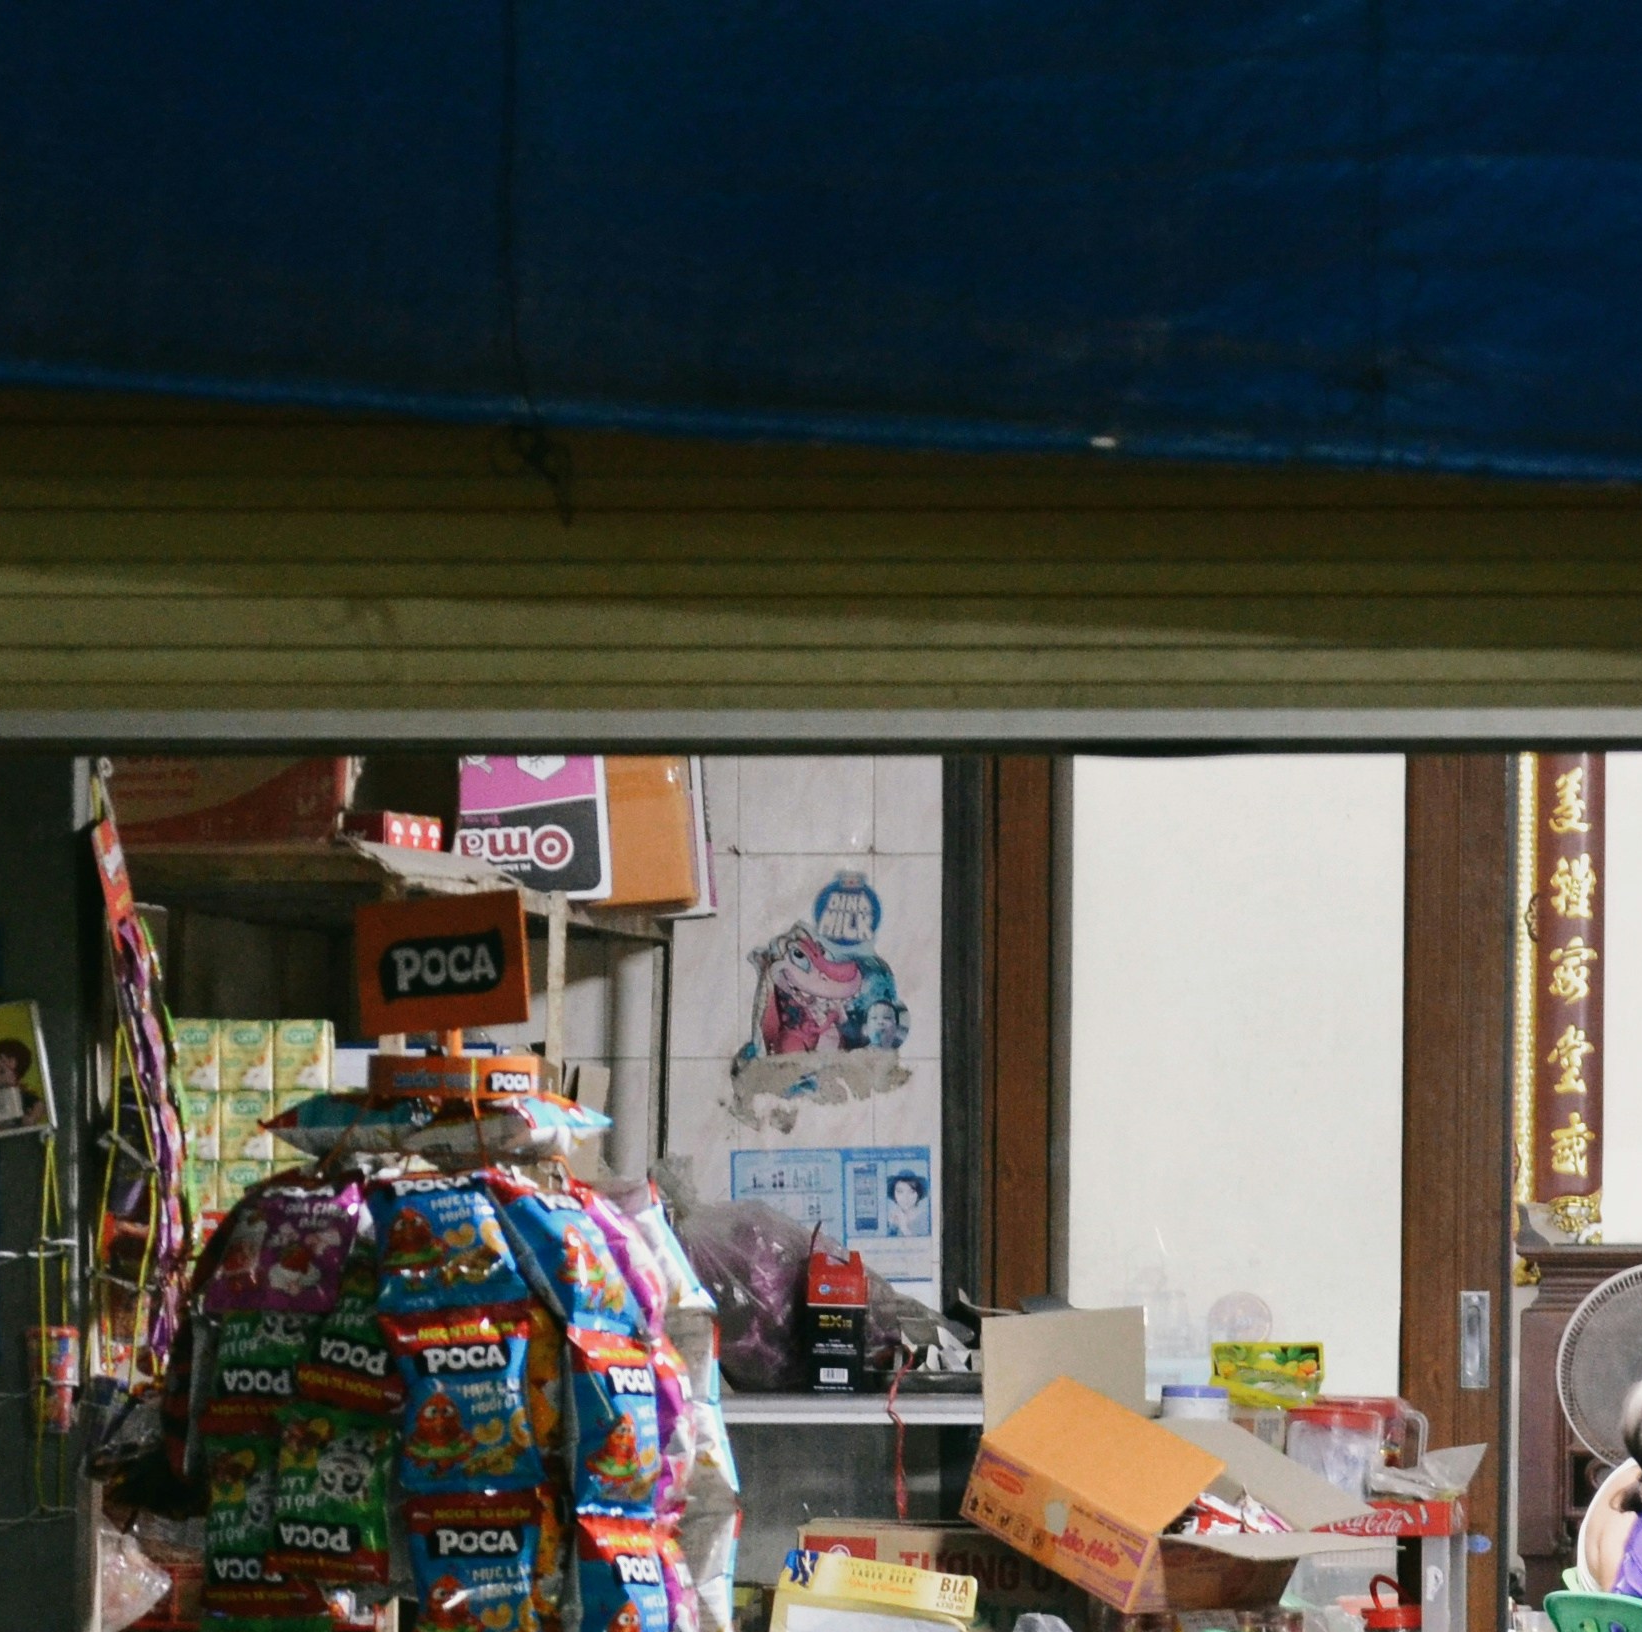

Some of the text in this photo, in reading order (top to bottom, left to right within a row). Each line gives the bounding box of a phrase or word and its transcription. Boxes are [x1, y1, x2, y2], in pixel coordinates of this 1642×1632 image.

[391, 943, 497, 992] POCA
[490, 1071, 530, 1092] POCA
[319, 1336, 389, 1376] POCA
[423, 1344, 506, 1374] POCA
[223, 1369, 292, 1396] POCA
[609, 1366, 655, 1394] POCA
[279, 1522, 351, 1553] POCA
[436, 1529, 518, 1555] POCA
[616, 1555, 659, 1583] POCA
[852, 1568, 883, 1580] LAGER
[940, 1577, 970, 1598] BIA
